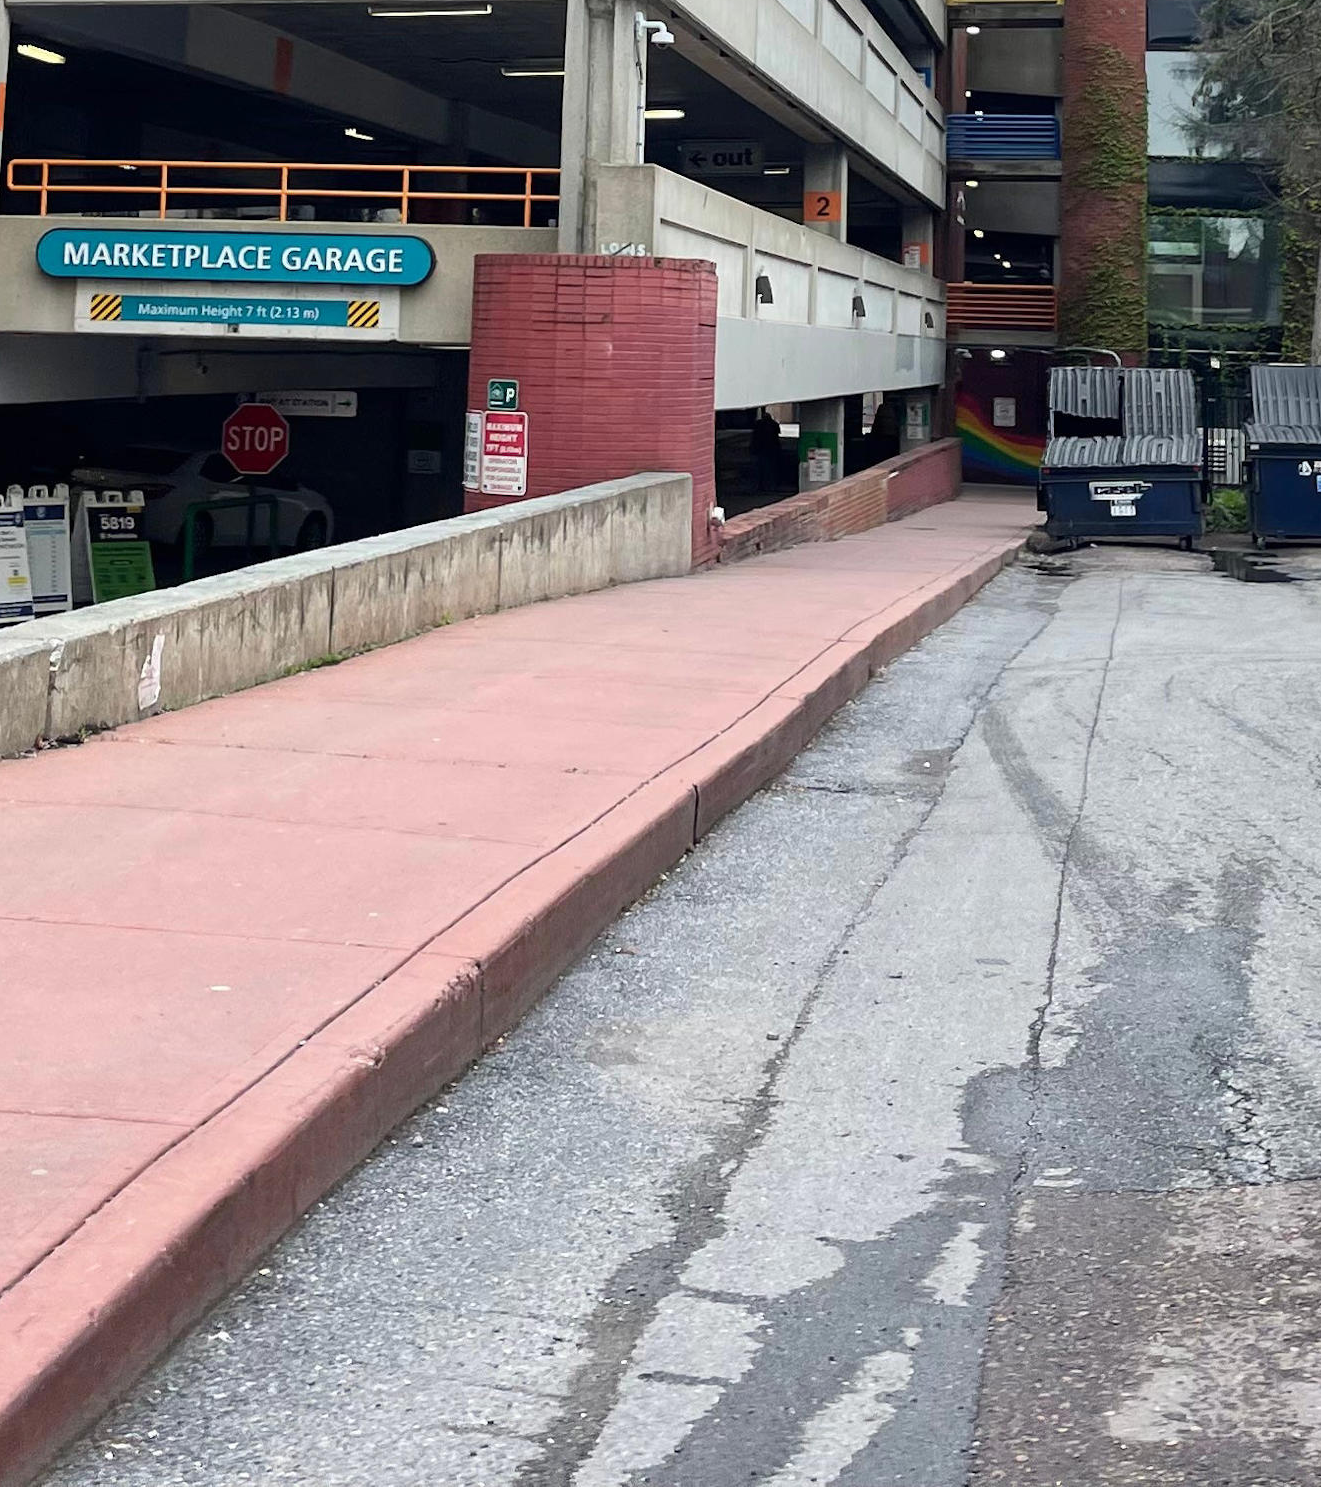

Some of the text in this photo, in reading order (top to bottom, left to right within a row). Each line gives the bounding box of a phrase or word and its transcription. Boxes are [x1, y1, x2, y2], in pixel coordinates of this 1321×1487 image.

[712, 147, 753, 167] out
[816, 196, 830, 217] 2
[63, 240, 404, 274] MARKETPLACE GARAGE
[137, 303, 320, 321] Maximum Height 7 ft (2.13 m)
[505, 387, 515, 403] P
[227, 425, 284, 452] STOP
[100, 516, 135, 530] 5819
